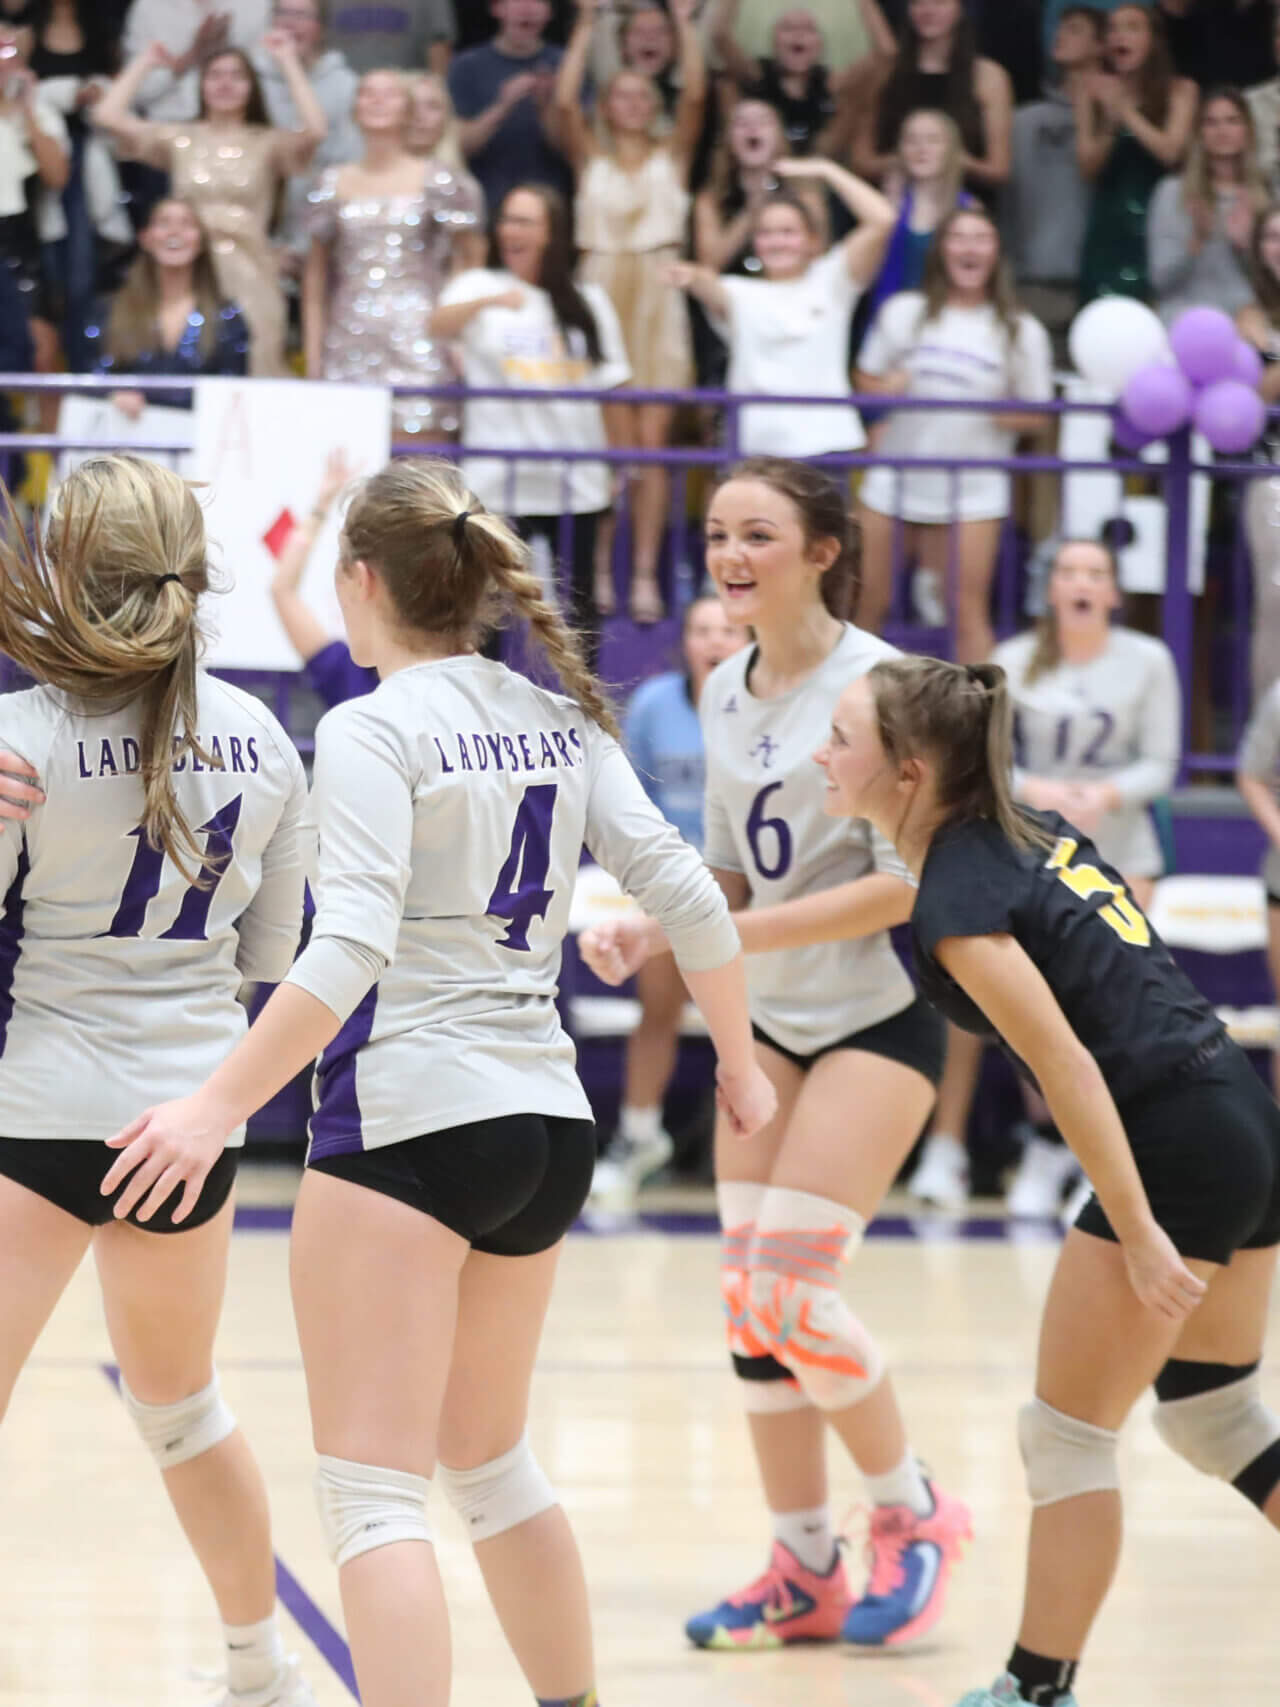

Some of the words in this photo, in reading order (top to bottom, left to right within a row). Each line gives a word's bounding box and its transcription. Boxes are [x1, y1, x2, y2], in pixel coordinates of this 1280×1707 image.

[77, 735, 260, 778] LADBEARS
[433, 728, 582, 774] LADYBEARS
[90, 791, 243, 940] 11
[484, 783, 559, 952] 4
[746, 780, 793, 881] 6
[1043, 836, 1151, 948] 5
